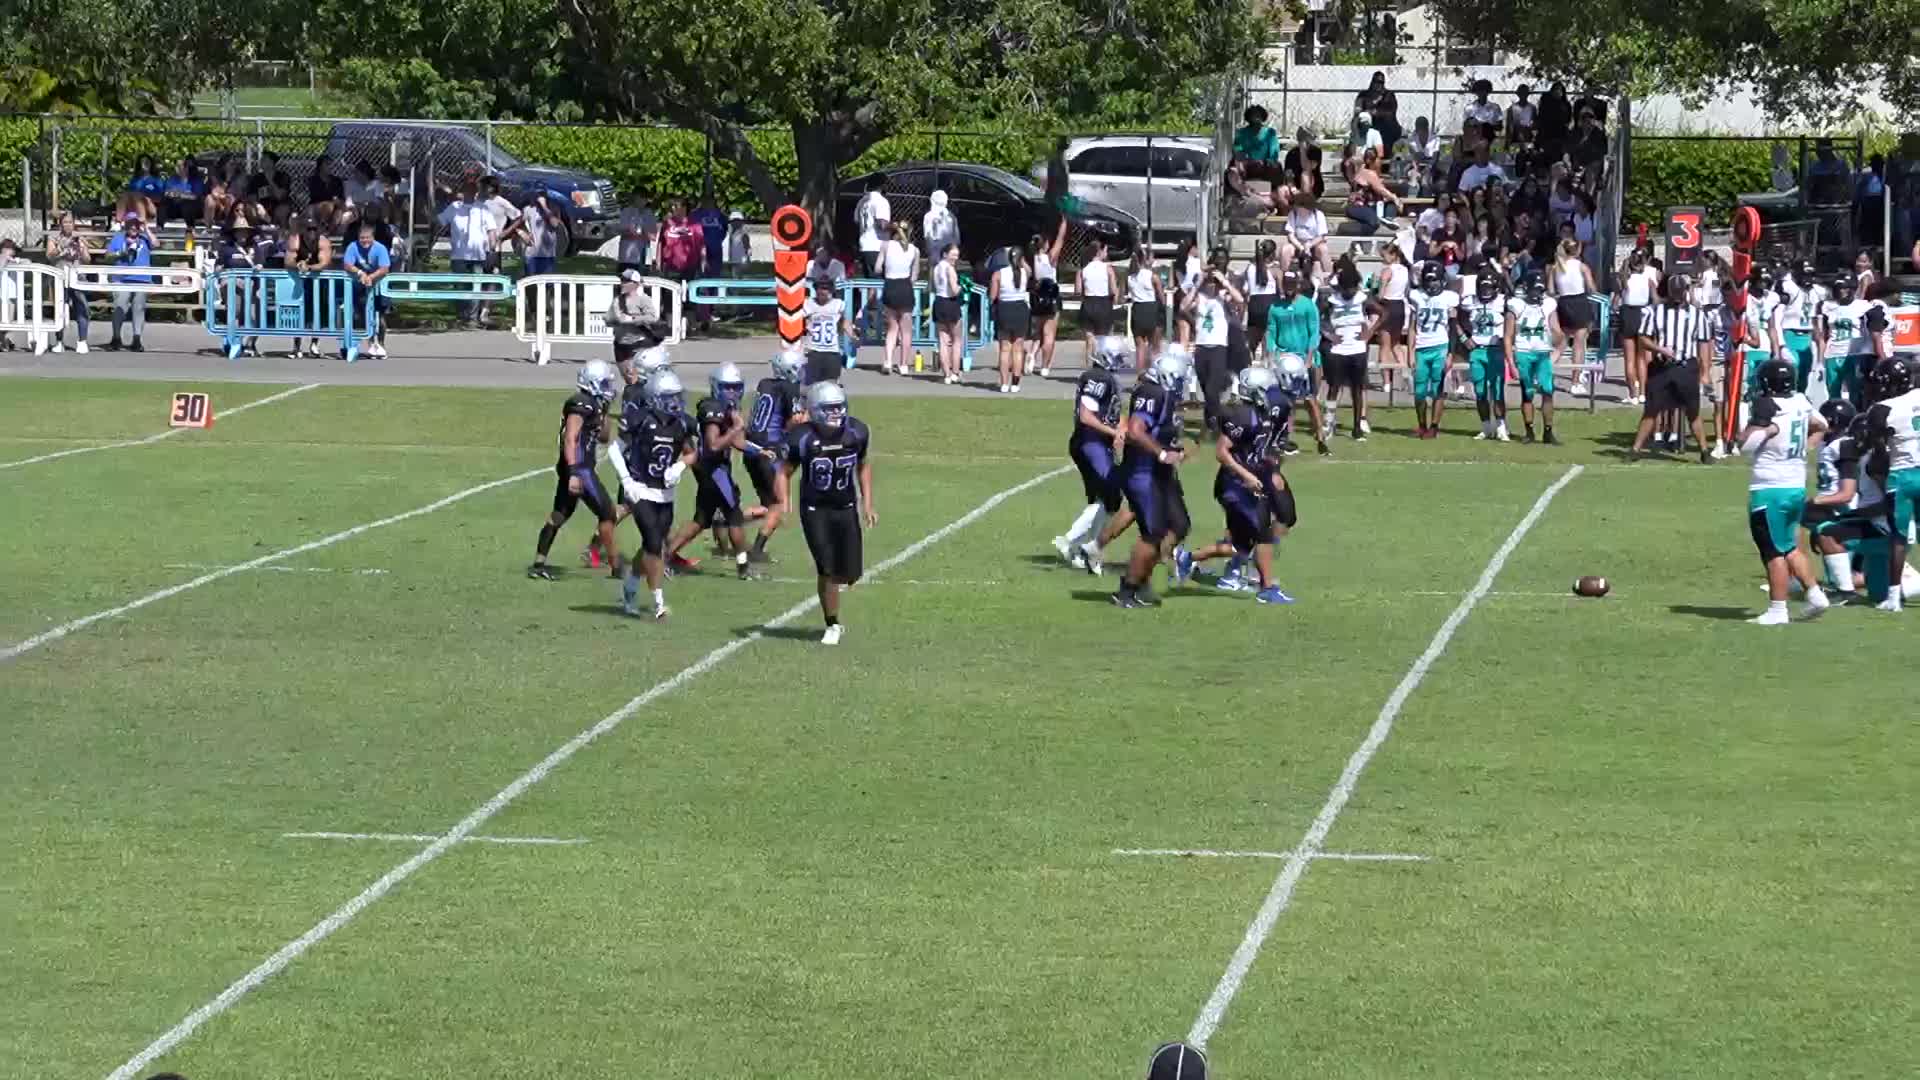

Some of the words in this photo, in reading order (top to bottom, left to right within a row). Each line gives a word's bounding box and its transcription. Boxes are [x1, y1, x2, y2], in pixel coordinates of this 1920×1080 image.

[1671, 213, 1700, 248] 3
[1419, 307, 1444, 333] 27
[174, 394, 205, 422] 30
[1790, 418, 1803, 459] 5
[648, 443, 674, 478] 3
[810, 453, 857, 490] 87
